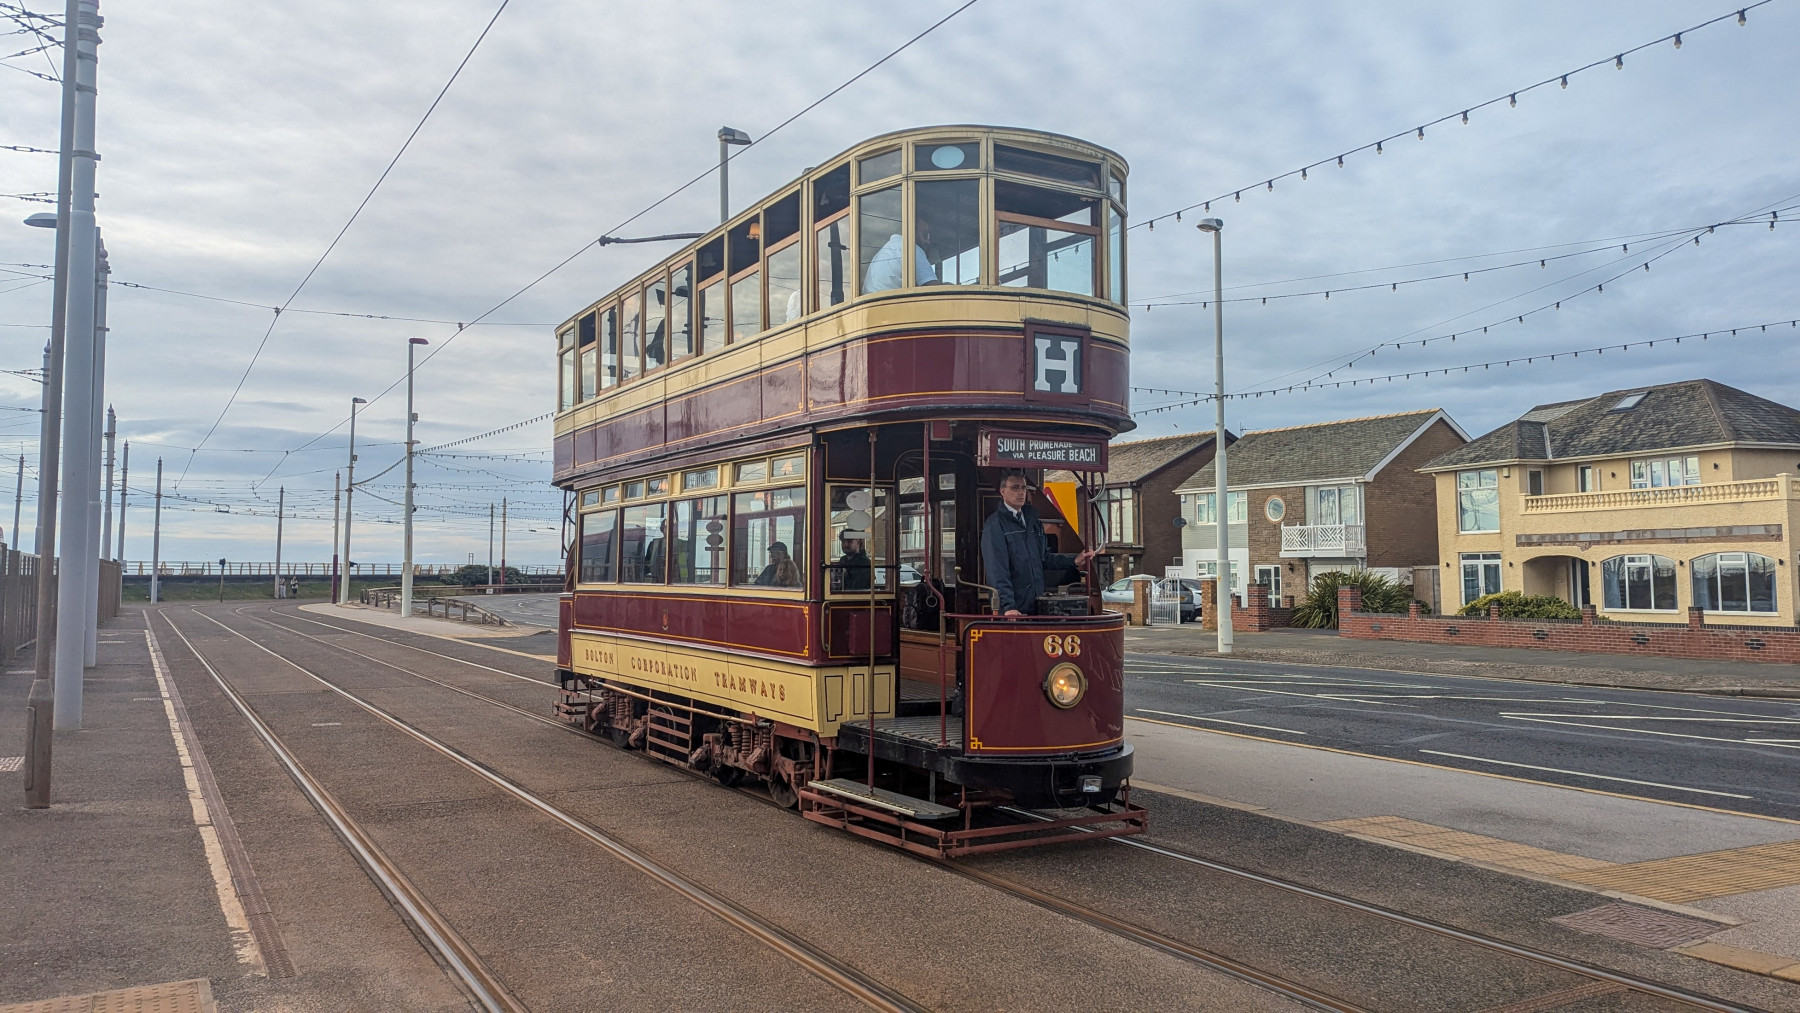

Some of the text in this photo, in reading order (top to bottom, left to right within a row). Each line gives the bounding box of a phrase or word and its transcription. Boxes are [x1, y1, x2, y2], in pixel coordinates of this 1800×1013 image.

[1034, 338, 1078, 394] H
[997, 438, 1073, 453] SOUTH PROMENADE
[1028, 451, 1066, 461] PLEASURE
[1069, 447, 1096, 462] BEACH
[1043, 634, 1082, 659] 66
[585, 648, 786, 702] BOLTON CORPORATION TRAMWAYS
